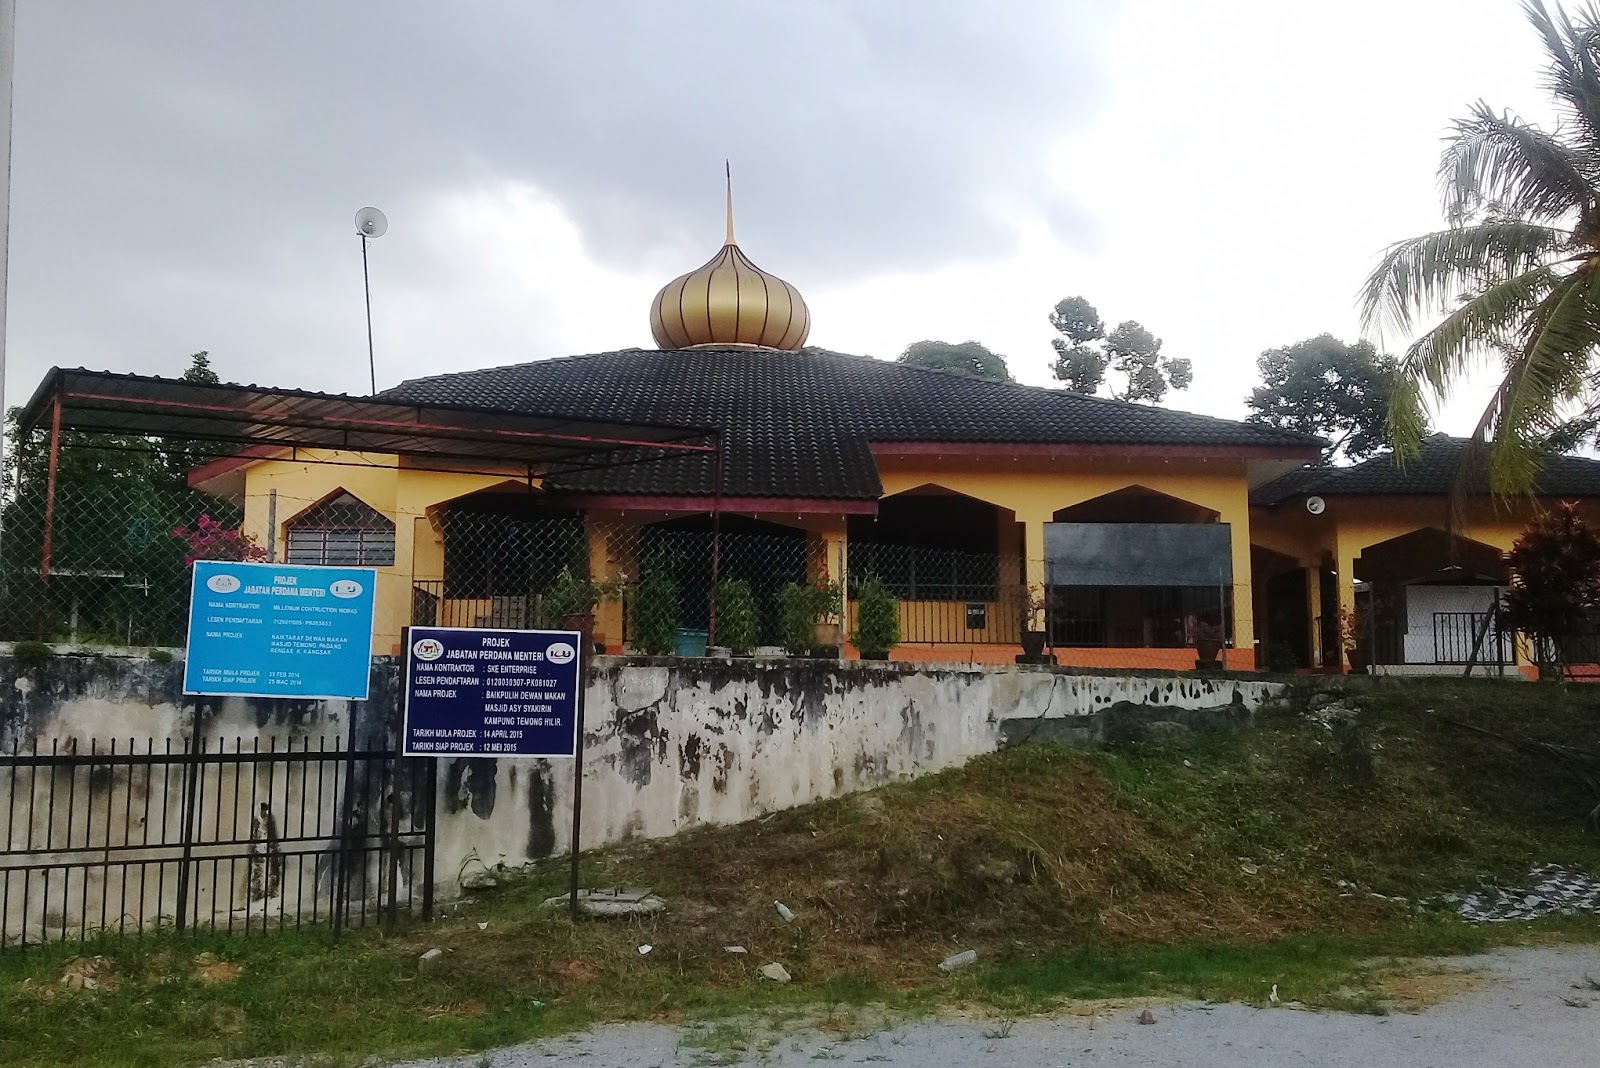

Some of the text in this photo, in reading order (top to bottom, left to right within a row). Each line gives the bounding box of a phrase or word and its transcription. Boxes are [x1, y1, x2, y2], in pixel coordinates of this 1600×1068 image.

[274, 576, 298, 586] PROJEK
[244, 586, 326, 598] JABATAN PERDANA MENTERI
[482, 638, 510, 648] PROJEK
[446, 650, 544, 662] JABATAN PERDANA MENTERI
[416, 662, 474, 672] NAMA KONTRAKTOR
[487, 664, 537, 674] SKE ENTERPRISE
[415, 676, 480, 686] LESEN PENDAFTARAN
[414, 689, 456, 698] NAMA PROJEK
[486, 690, 566, 700] BAIKPULIH DEWAN MAKAN
[484, 704, 552, 713] MASJID ASY SYAKIRIN
[484, 716, 515, 726] KAMPUNG
[516, 717, 543, 726] TEMONG
[413, 728, 476, 738] TARIKH MULA PROJEK
[484, 730, 523, 738] 14 APRIL 2015
[412, 742, 474, 752] TARIKH SIAP PROJEK
[484, 743, 517, 752] 12 MEI 2015
